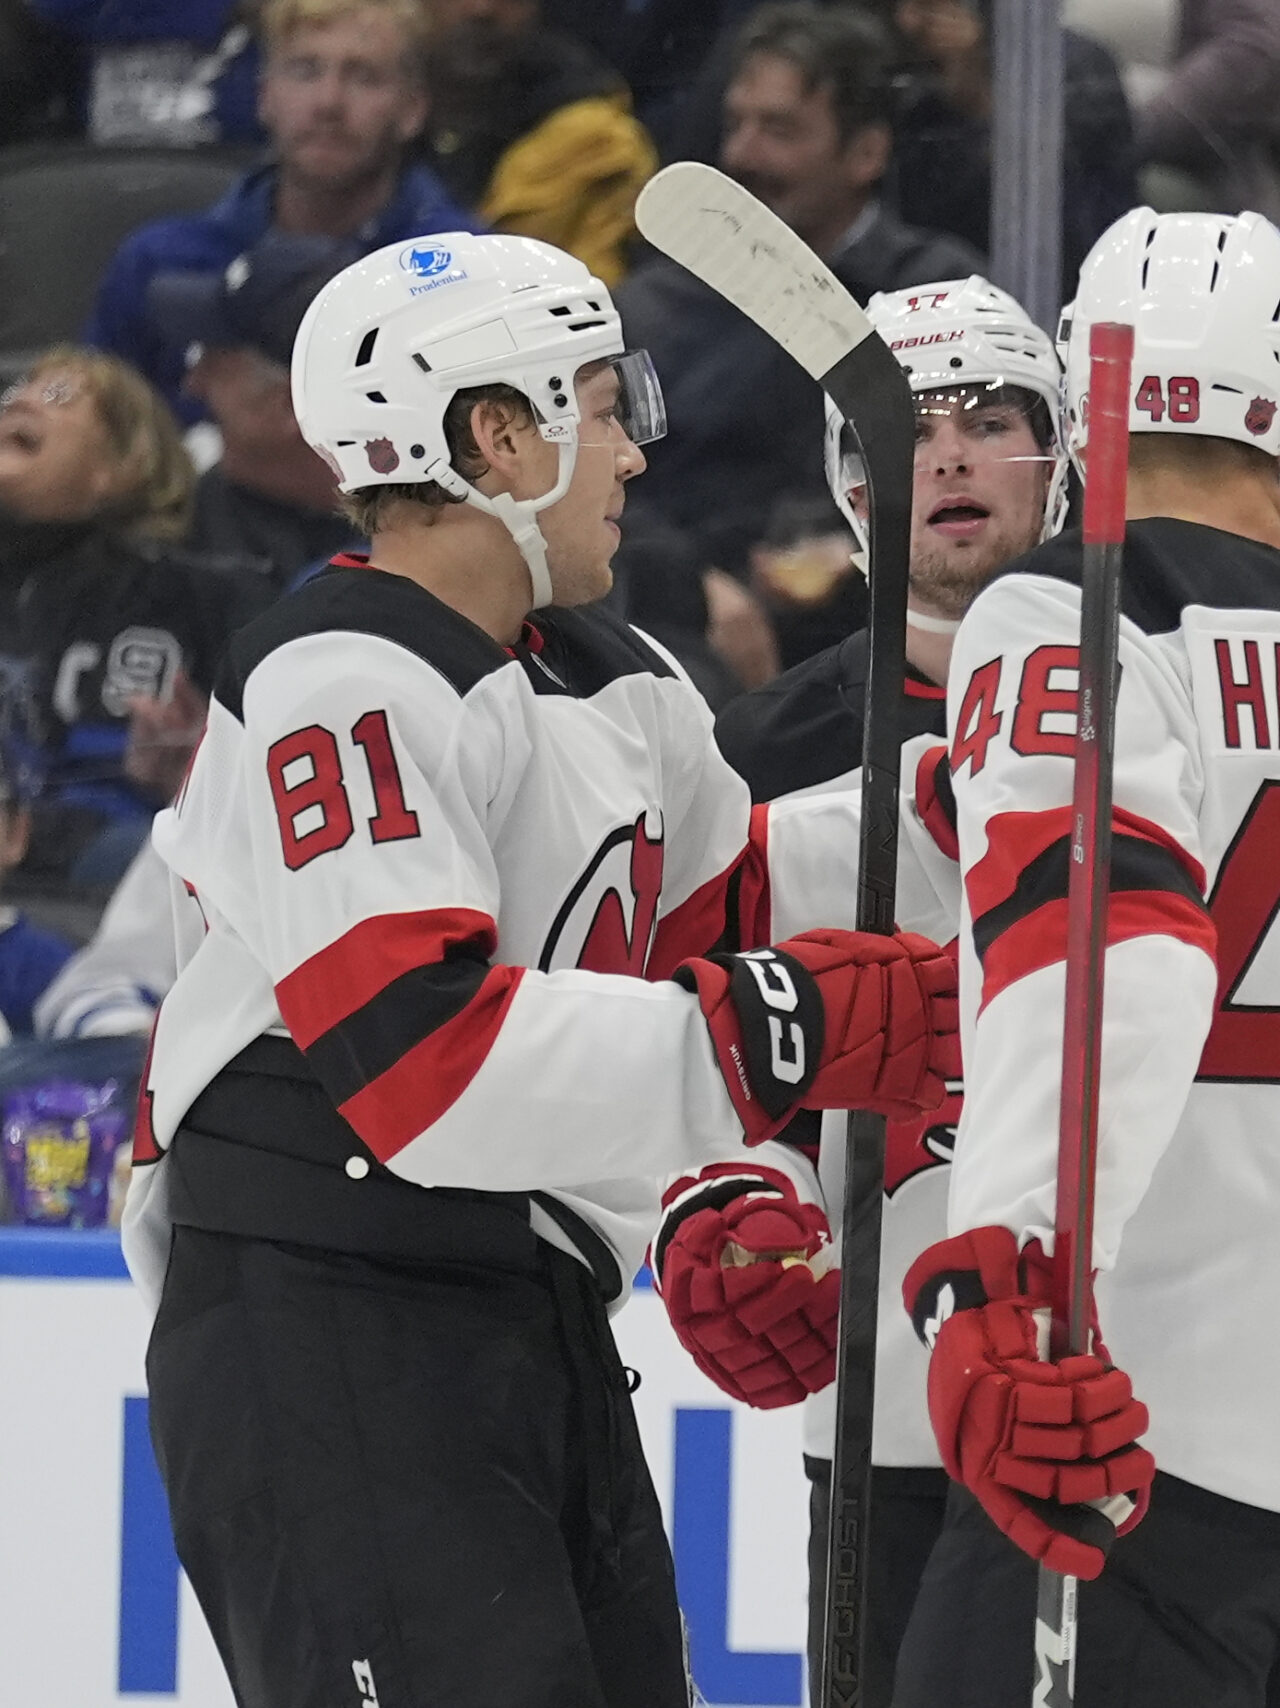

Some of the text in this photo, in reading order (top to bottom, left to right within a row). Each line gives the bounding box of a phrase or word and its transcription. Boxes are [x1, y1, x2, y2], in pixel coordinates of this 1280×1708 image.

[408, 269, 468, 296] Prudential
[1135, 375, 1201, 423] 48
[951, 644, 1124, 780] 48
[266, 708, 422, 873] 81
[728, 1043, 753, 1101] GRITSYUK
